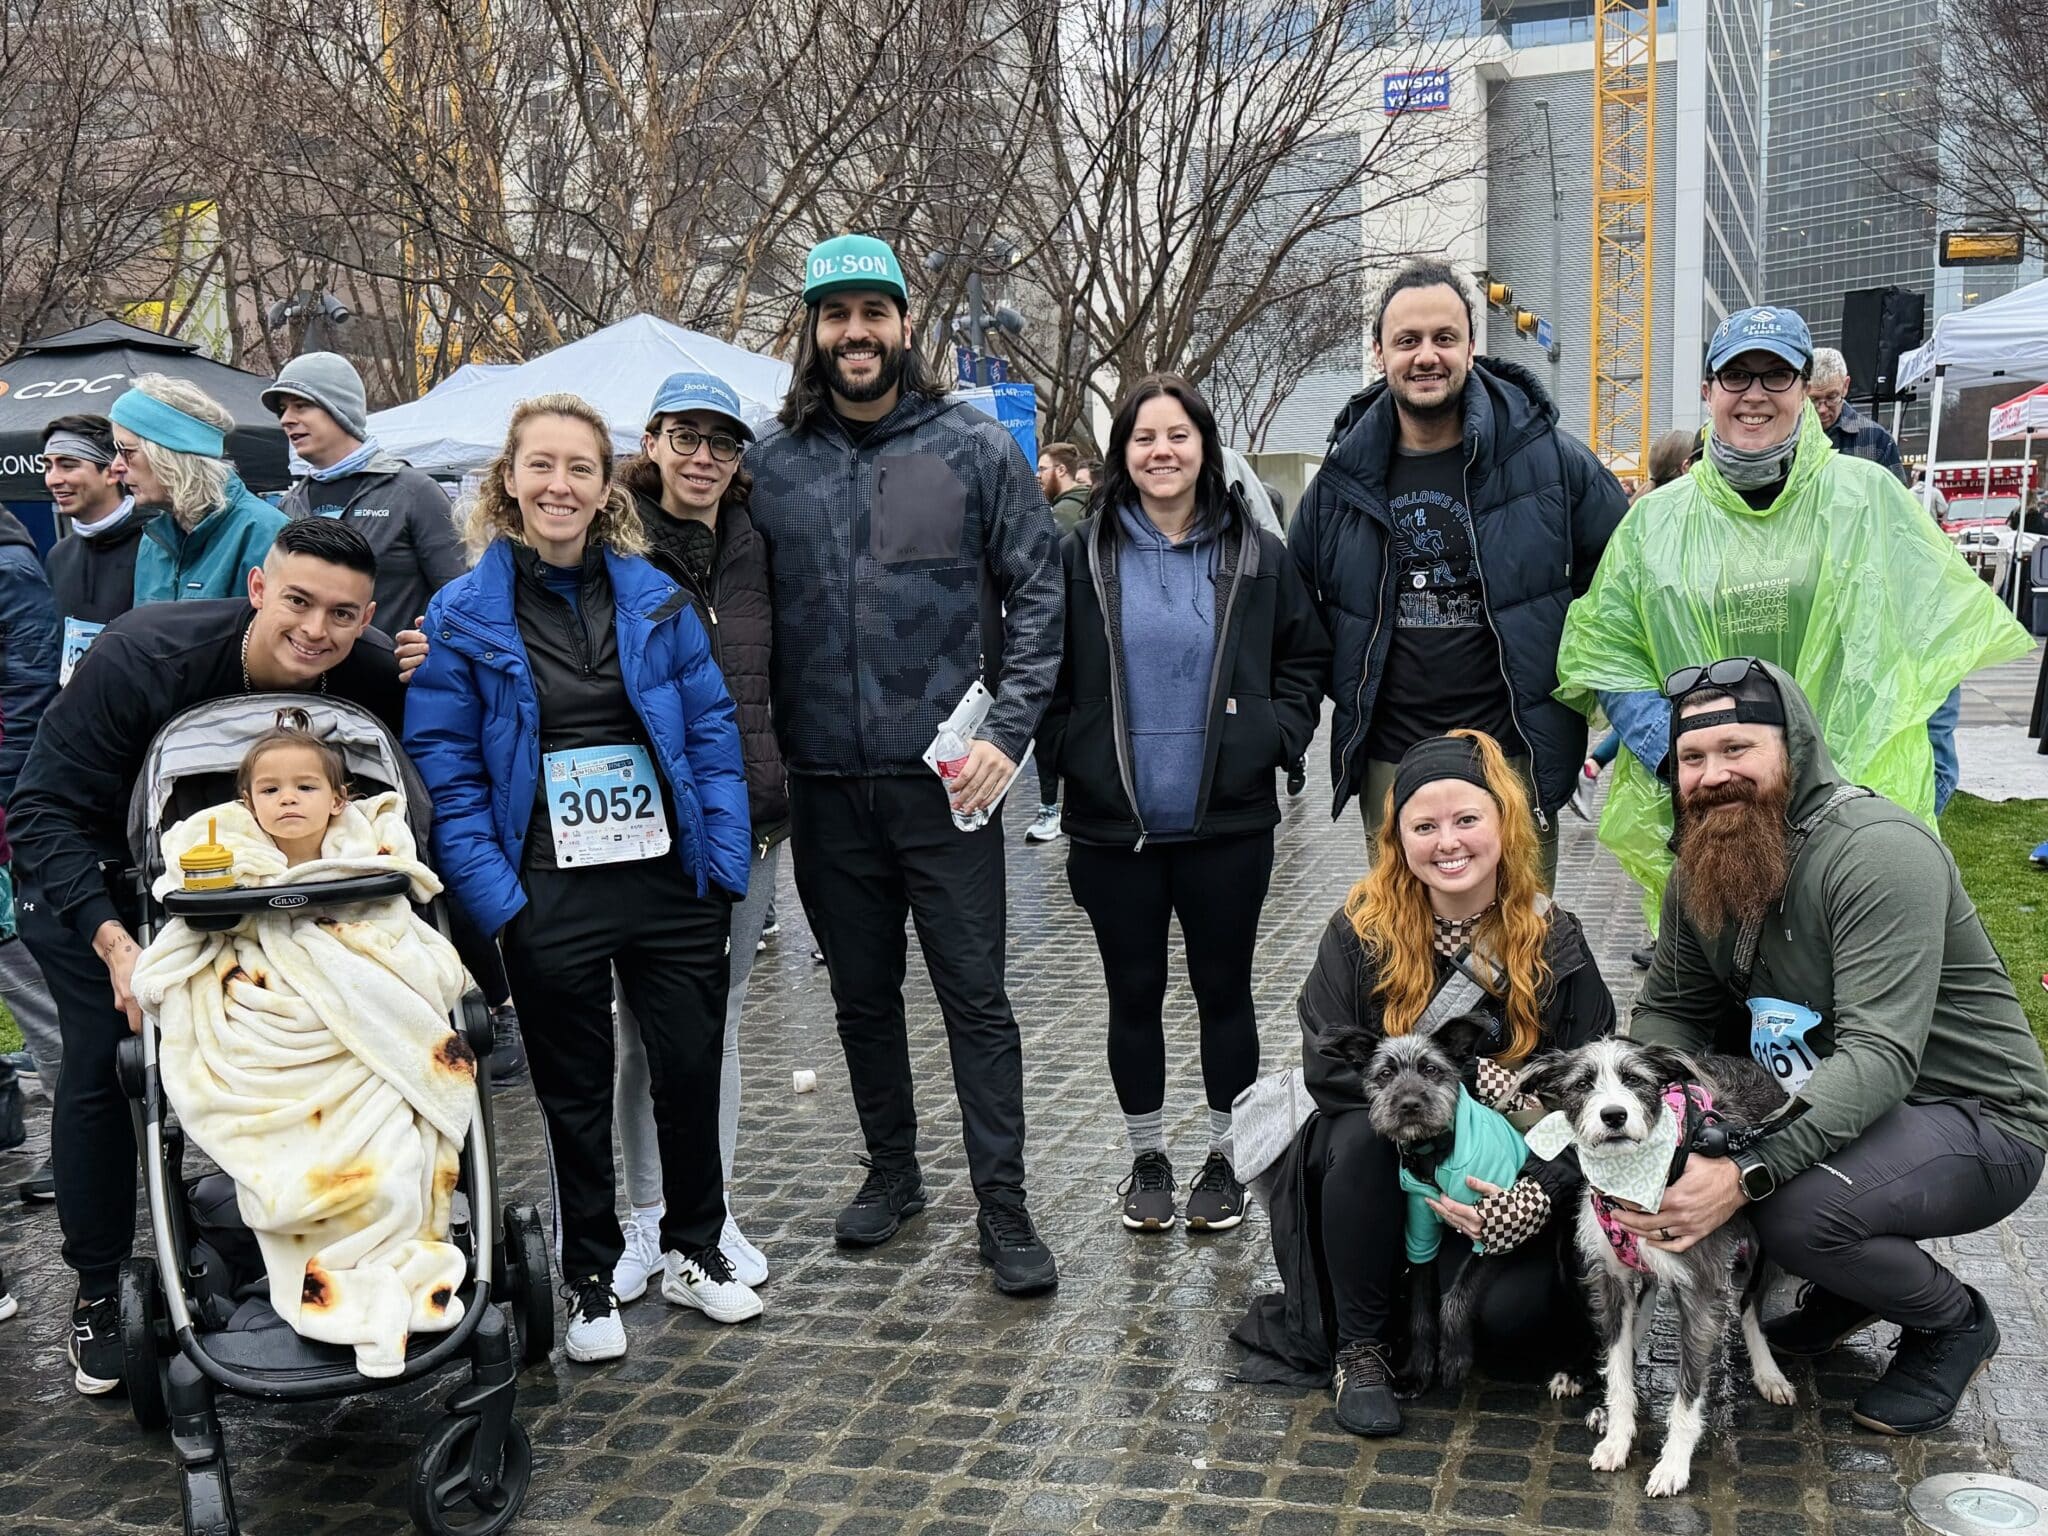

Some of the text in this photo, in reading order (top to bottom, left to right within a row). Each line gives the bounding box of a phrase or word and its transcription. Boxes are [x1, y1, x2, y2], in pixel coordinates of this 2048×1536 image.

[1388, 76, 1445, 91] AVISON
[812, 254, 888, 279] OL'SON
[13, 374, 125, 399] CDC
[0, 455, 46, 475] ONS
[559, 784, 655, 827] 3052
[274, 897, 305, 905] GRACO
